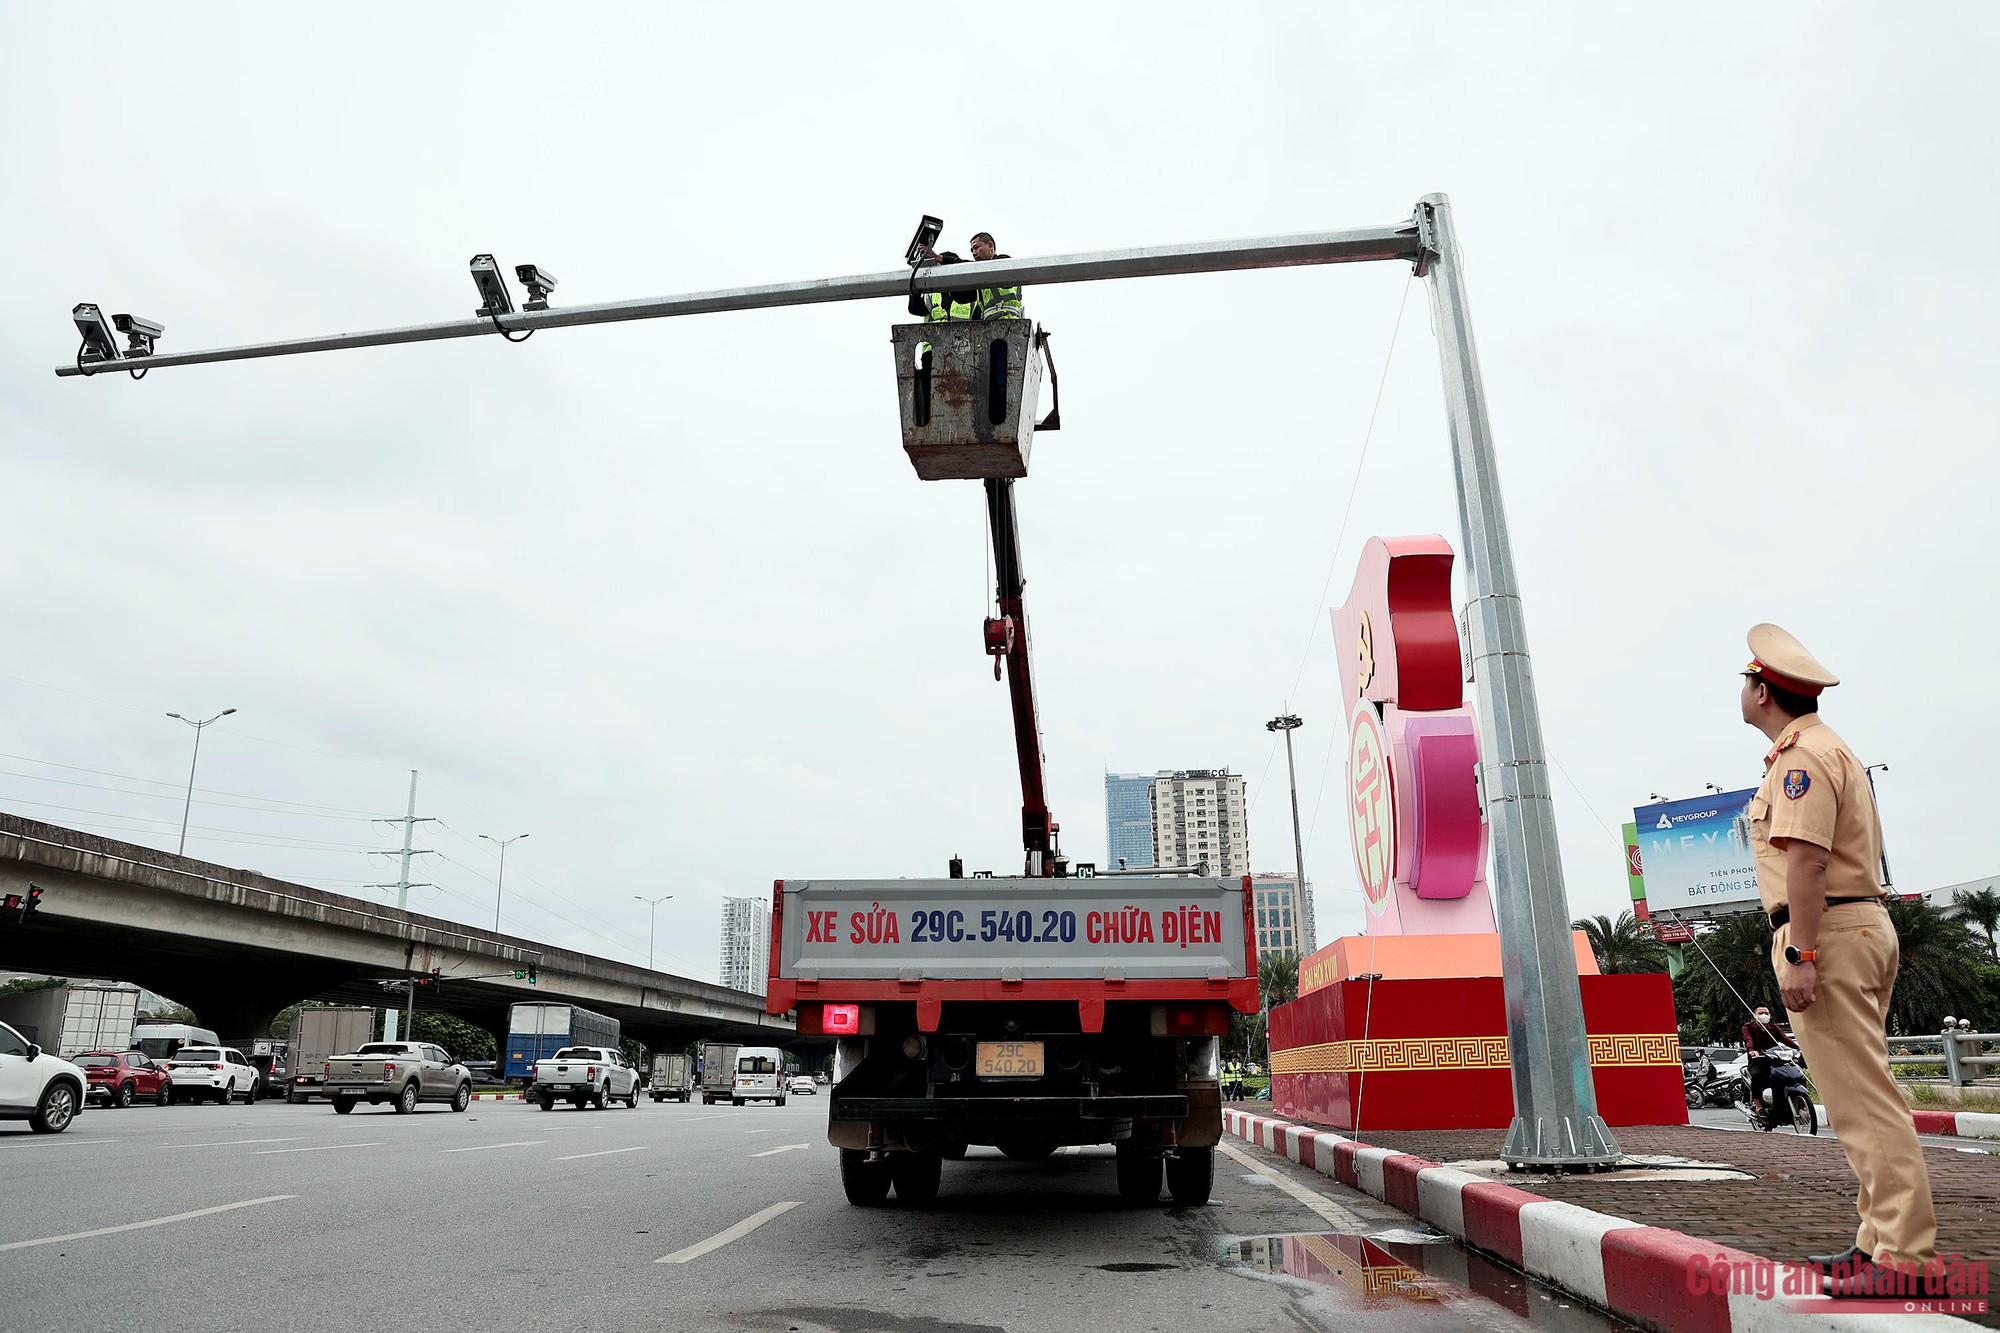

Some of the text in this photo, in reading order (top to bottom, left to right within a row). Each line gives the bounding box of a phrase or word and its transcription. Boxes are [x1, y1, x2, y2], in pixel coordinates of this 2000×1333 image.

[1671, 809, 1718, 823] MEYGROUP
[1730, 866, 1757, 875] PHON
[1688, 876, 1759, 896] BẤT ĐỘNG SẢ
[805, 910, 838, 943] XE
[849, 901, 900, 945] SỬA
[1086, 904, 1155, 944] CHỮA
[515, 970, 526, 979] 04
[1313, 956, 1324, 990] HỘI
[996, 1044, 1024, 1058] 29C
[984, 1059, 1036, 1073] 540.20
